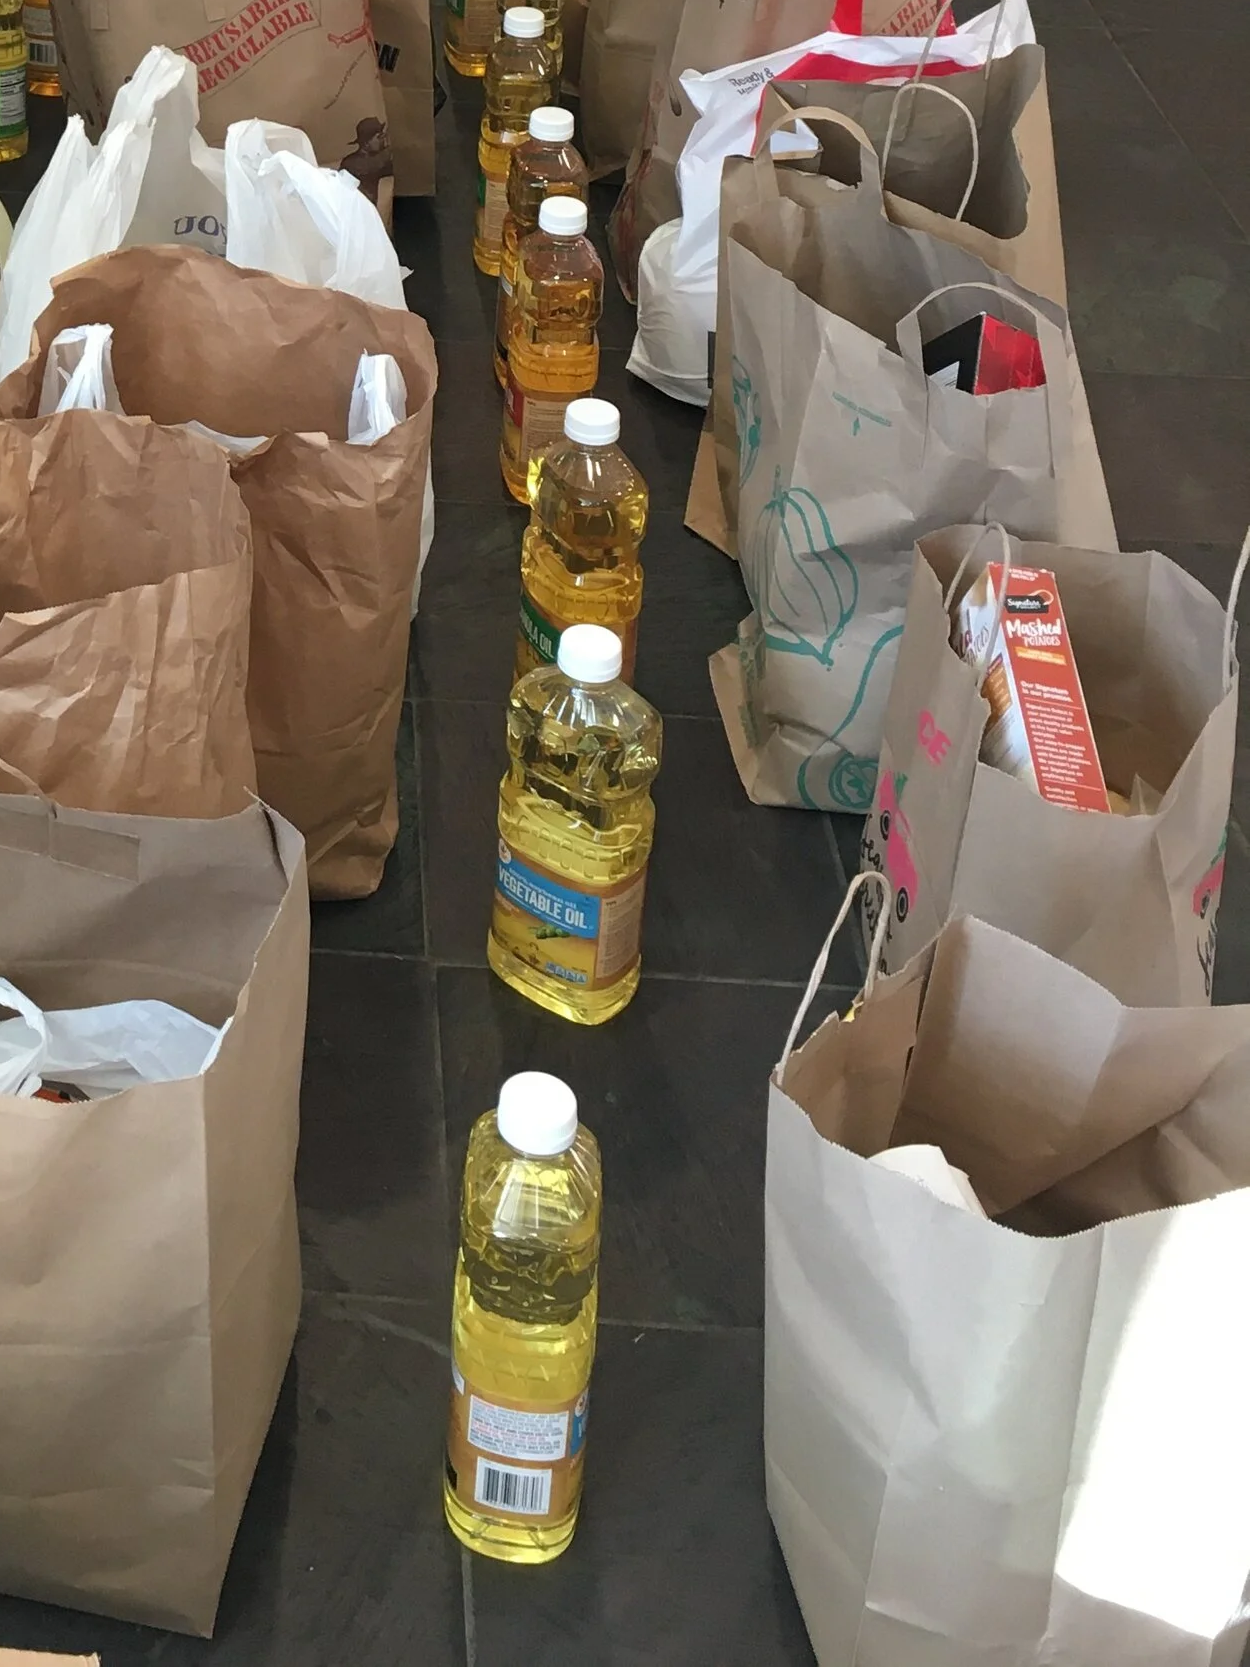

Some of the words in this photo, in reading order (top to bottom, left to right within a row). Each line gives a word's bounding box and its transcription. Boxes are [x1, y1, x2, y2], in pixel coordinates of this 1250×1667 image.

[728, 71, 766, 87] Ready
[763, 67, 775, 79] &
[1007, 596, 1041, 610] Signature
[1006, 617, 1062, 639] Mashed
[1022, 635, 1061, 647] POTATOES
[498, 864, 563, 920] VEGETABLE
[565, 906, 588, 930] OIL
